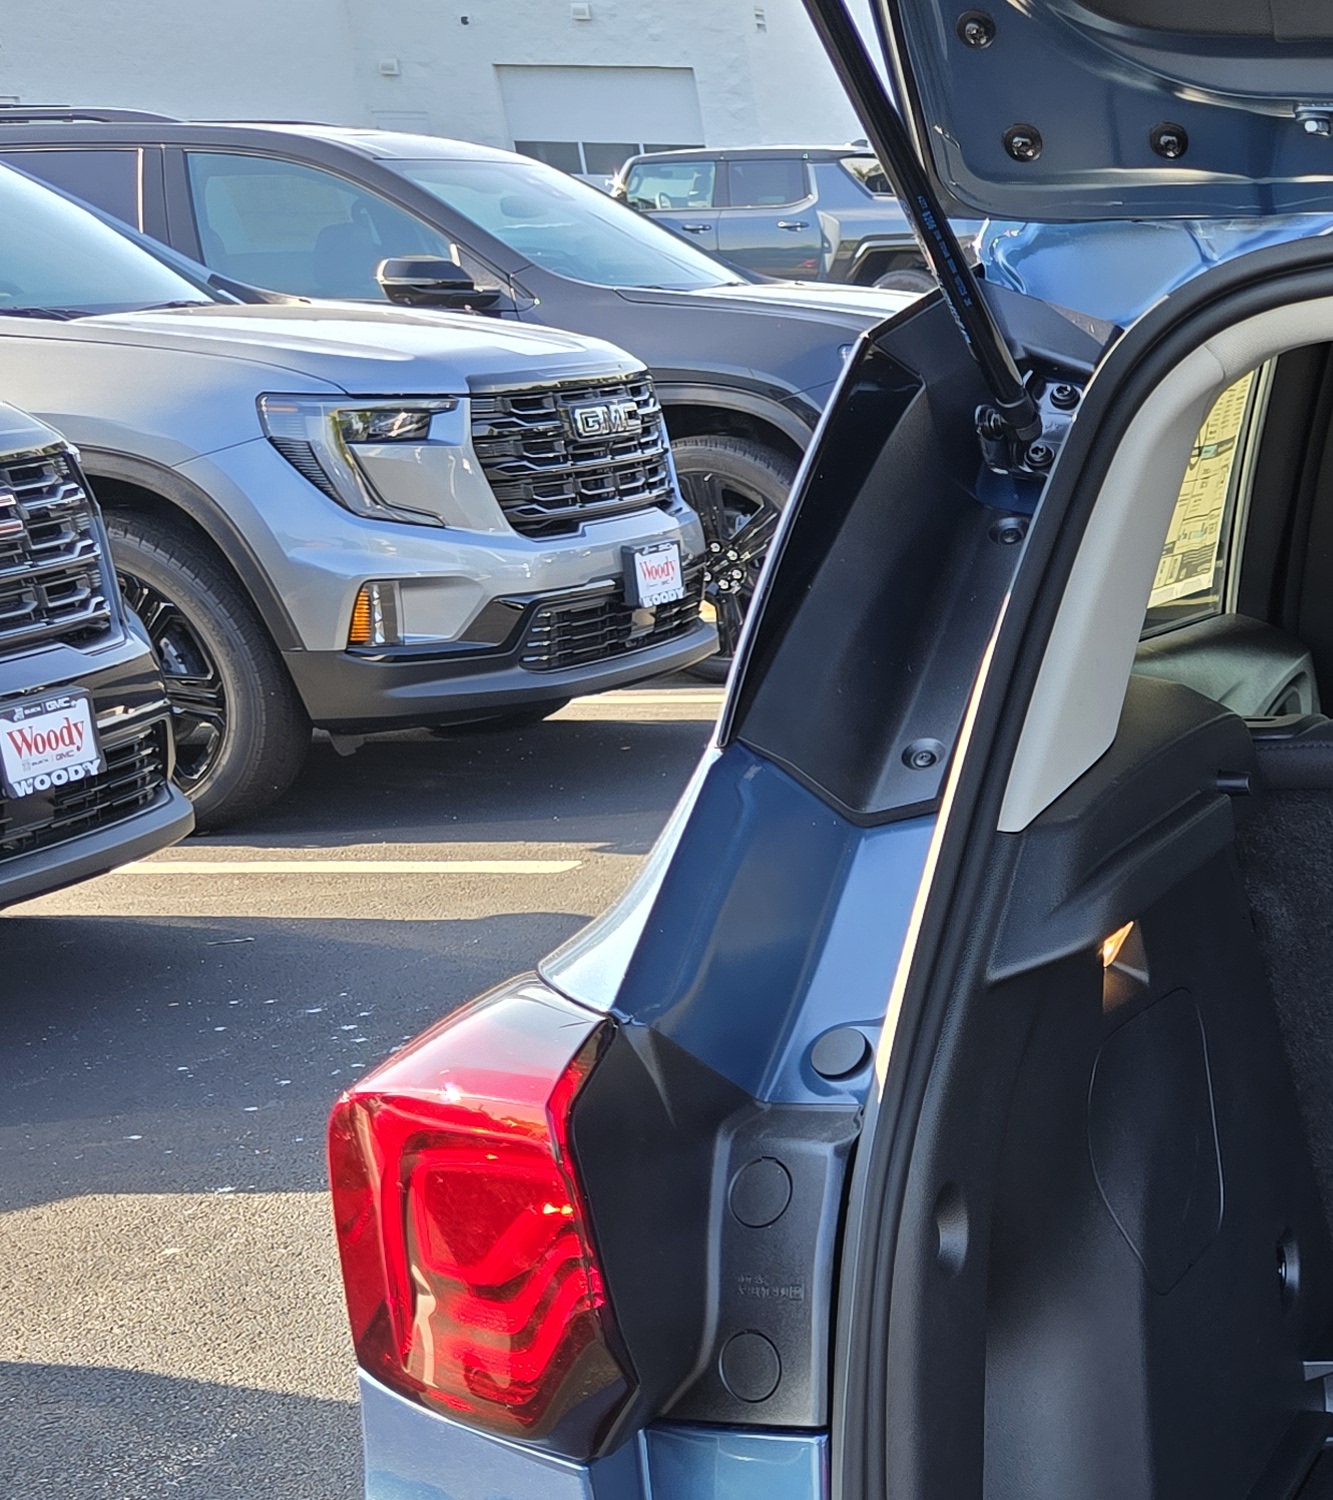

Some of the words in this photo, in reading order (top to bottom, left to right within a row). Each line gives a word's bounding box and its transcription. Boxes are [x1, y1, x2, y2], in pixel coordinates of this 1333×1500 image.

[574, 402, 641, 437] GMC
[639, 556, 676, 581] Woody
[6, 717, 84, 760] Woody
[12, 759, 101, 797] WOODY
